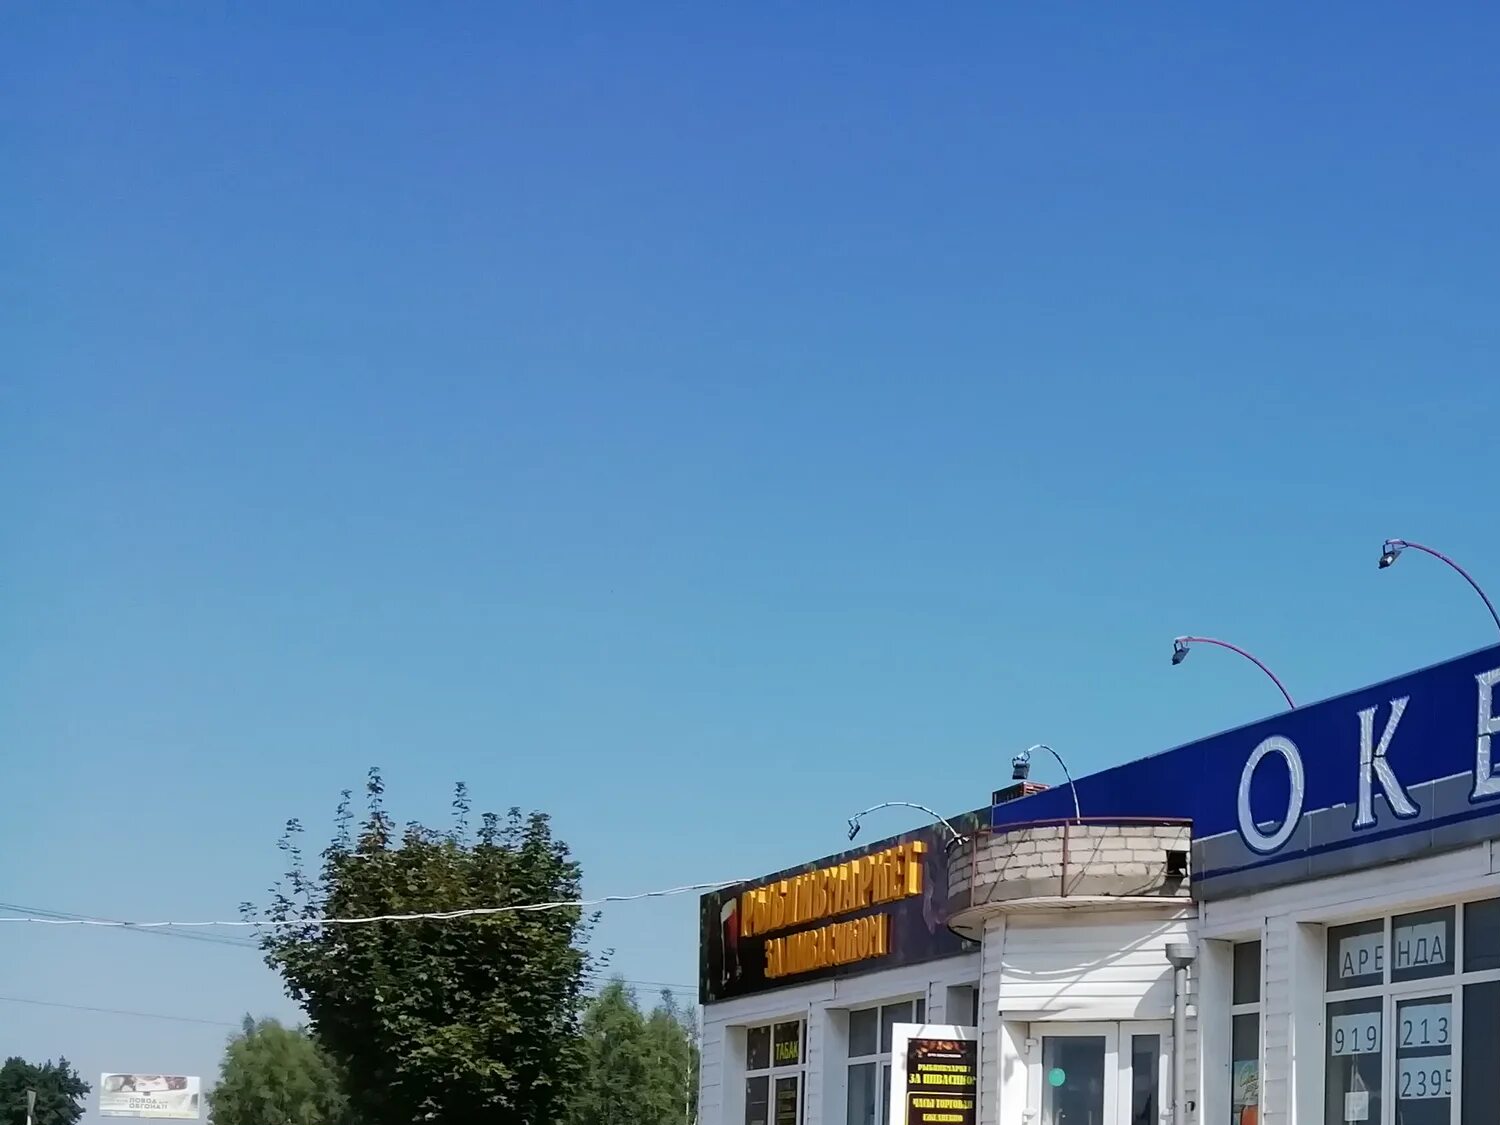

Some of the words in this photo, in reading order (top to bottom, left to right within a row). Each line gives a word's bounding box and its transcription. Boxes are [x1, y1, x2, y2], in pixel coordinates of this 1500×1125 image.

[1342, 935, 1444, 977] АРЕНДА
[1335, 1025, 1377, 1053] 919
[1403, 1017, 1448, 1045] 213
[776, 1040, 799, 1060] ТАБАК
[909, 1073, 921, 1084] ЗА
[1401, 1069, 1452, 1097] 2395
